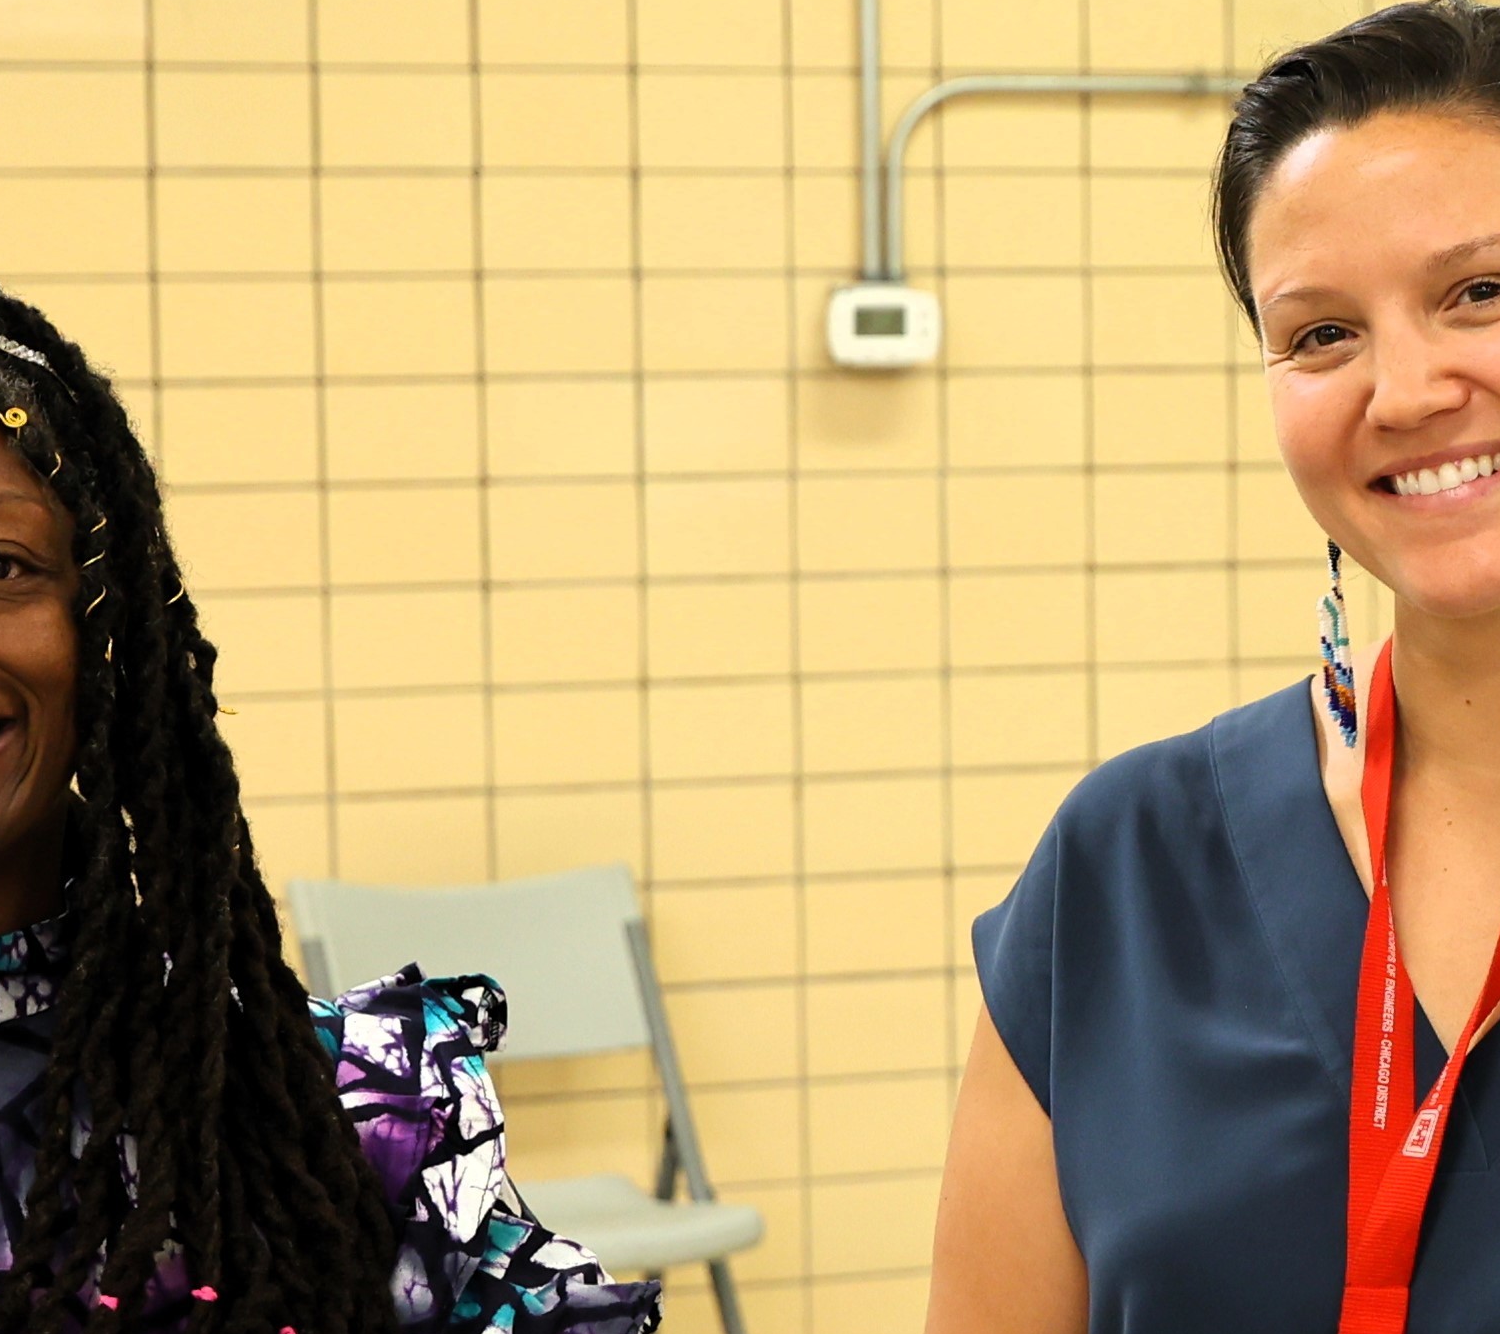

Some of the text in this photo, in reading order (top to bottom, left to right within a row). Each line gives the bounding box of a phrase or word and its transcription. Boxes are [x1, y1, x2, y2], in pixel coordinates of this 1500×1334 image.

[1386, 964, 1396, 978] OF
[1382, 978, 1396, 1033] ENGINEERS
[1378, 1039, 1392, 1085] CHICAGO
[1373, 1085, 1389, 1130] DISTRICT
